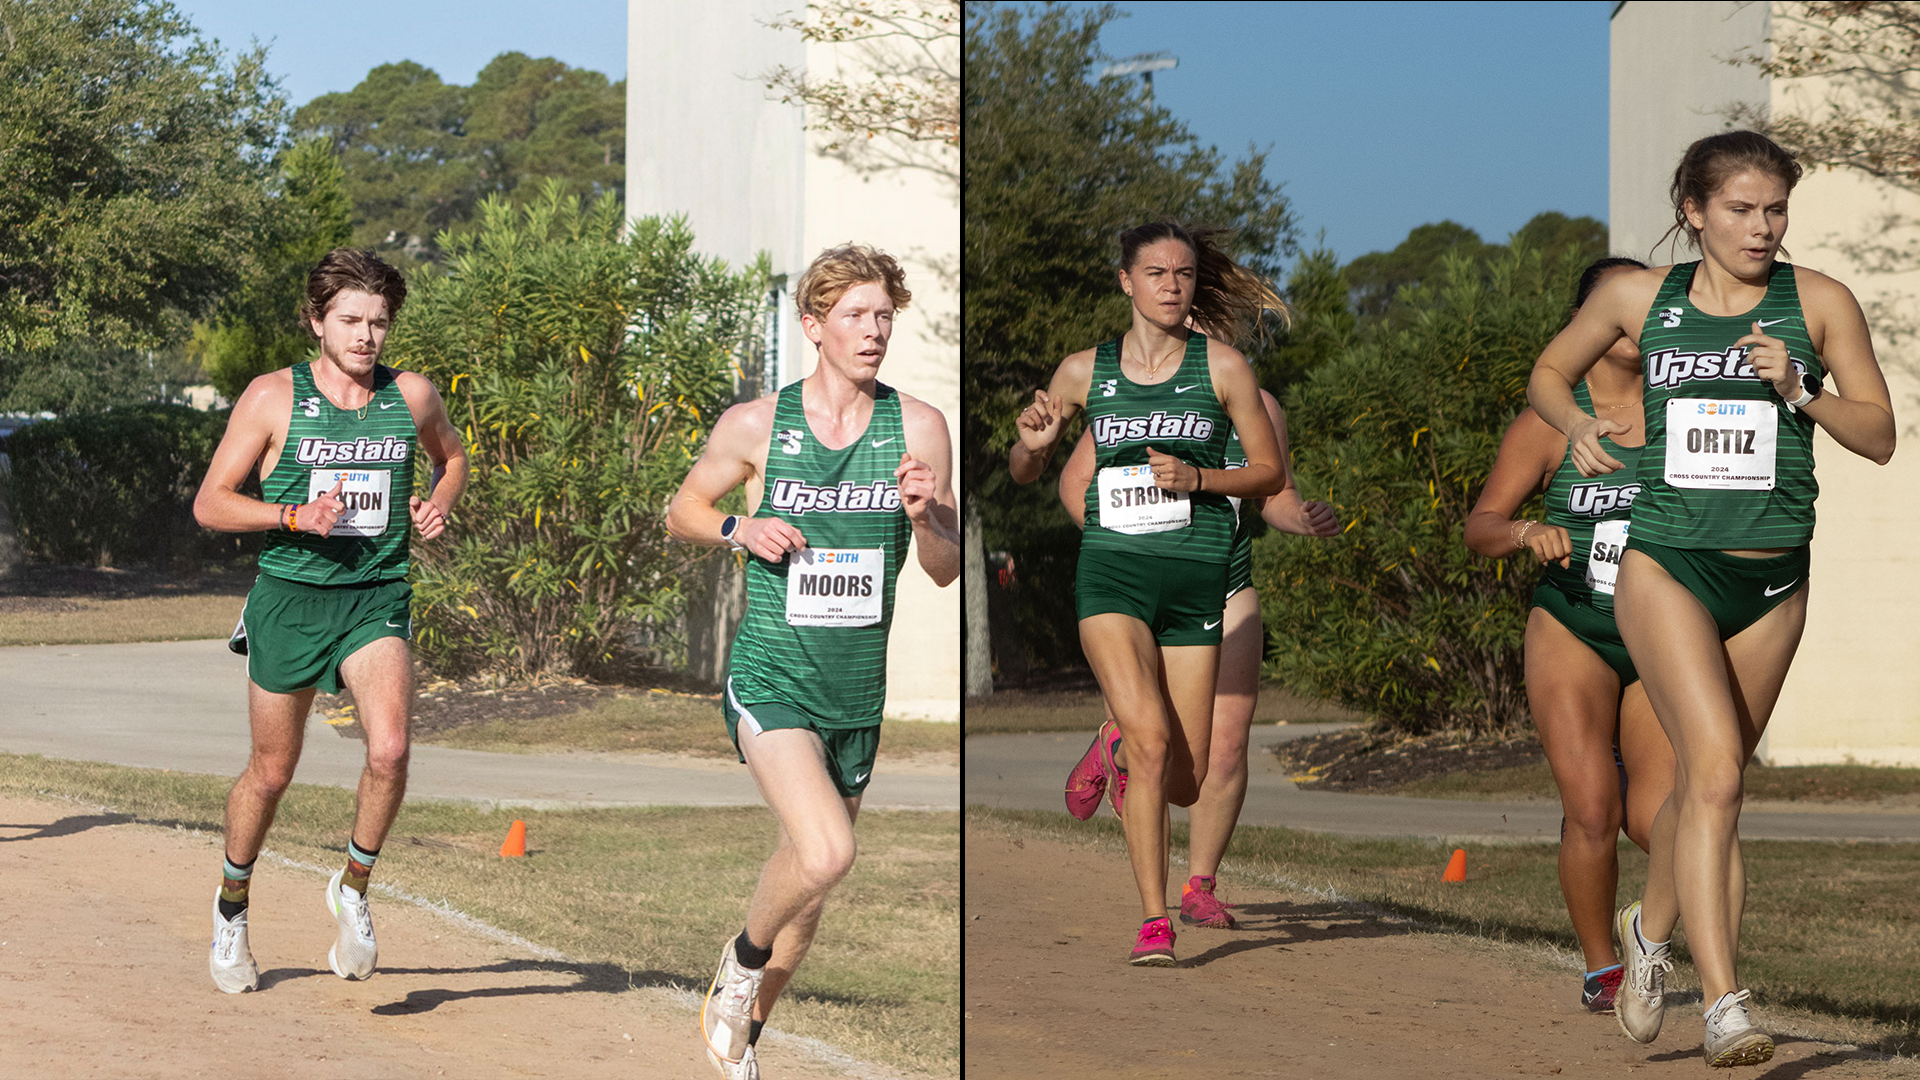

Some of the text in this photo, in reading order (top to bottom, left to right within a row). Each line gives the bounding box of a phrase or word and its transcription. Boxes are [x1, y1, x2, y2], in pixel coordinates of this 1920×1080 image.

[1697, 403, 1746, 415] SOUTH
[1094, 411, 1214, 448] Upstate
[1687, 427, 1756, 454] ORTIZ
[296, 436, 408, 467] Upstate
[334, 472, 369, 482] SOUTH
[1123, 466, 1152, 476] SOUT
[770, 477, 903, 515] Upstate
[1147, 518, 1188, 526] CHAMPIONSHIP
[818, 552, 859, 563] SOUTH
[799, 573, 873, 597] MOORS
